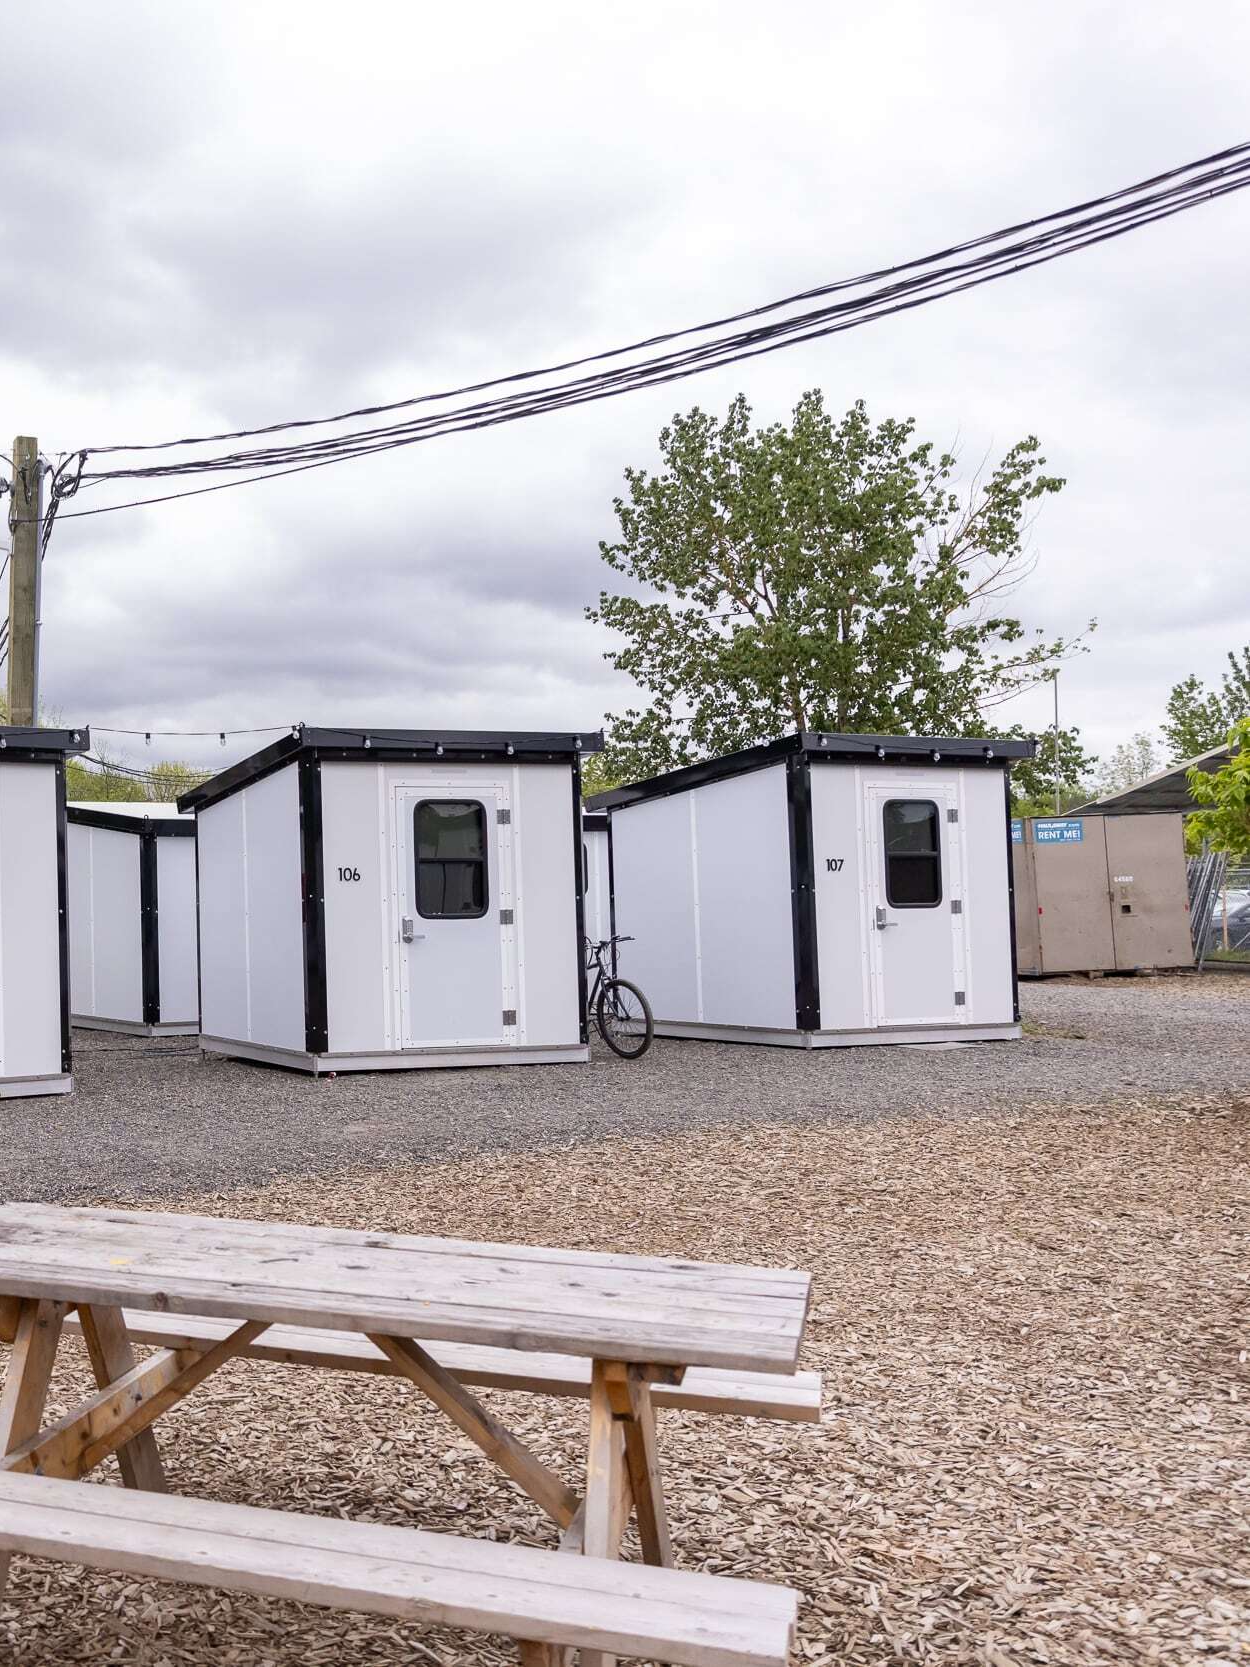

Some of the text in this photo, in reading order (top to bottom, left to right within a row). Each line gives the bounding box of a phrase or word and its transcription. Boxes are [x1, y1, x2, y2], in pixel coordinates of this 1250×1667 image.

[1038, 830, 1081, 840] RENT ME!
[826, 858, 844, 872] 107
[338, 867, 361, 882] 106
